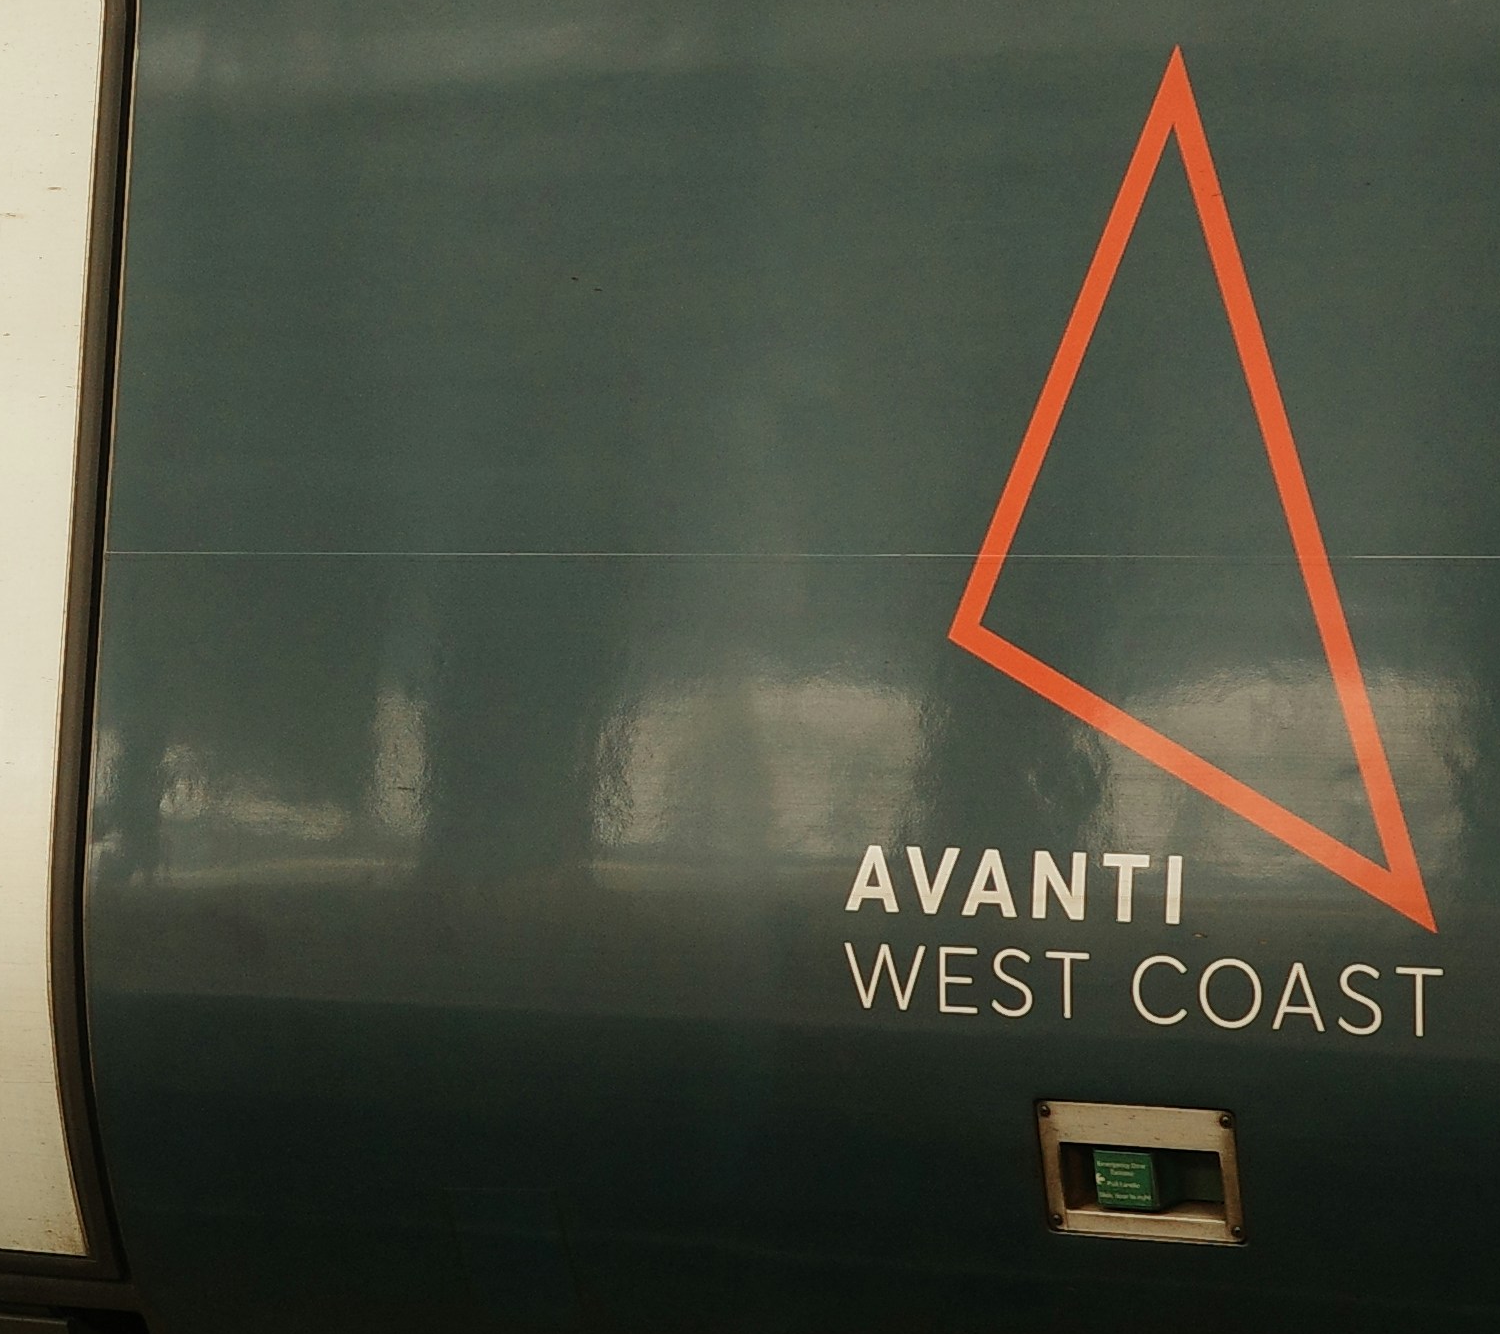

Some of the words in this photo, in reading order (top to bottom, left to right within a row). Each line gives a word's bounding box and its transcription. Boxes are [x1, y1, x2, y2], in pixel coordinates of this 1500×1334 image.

[844, 844, 1183, 925] AVANTI
[844, 941, 1091, 1020] WEST
[1131, 954, 1445, 1038] COAST
